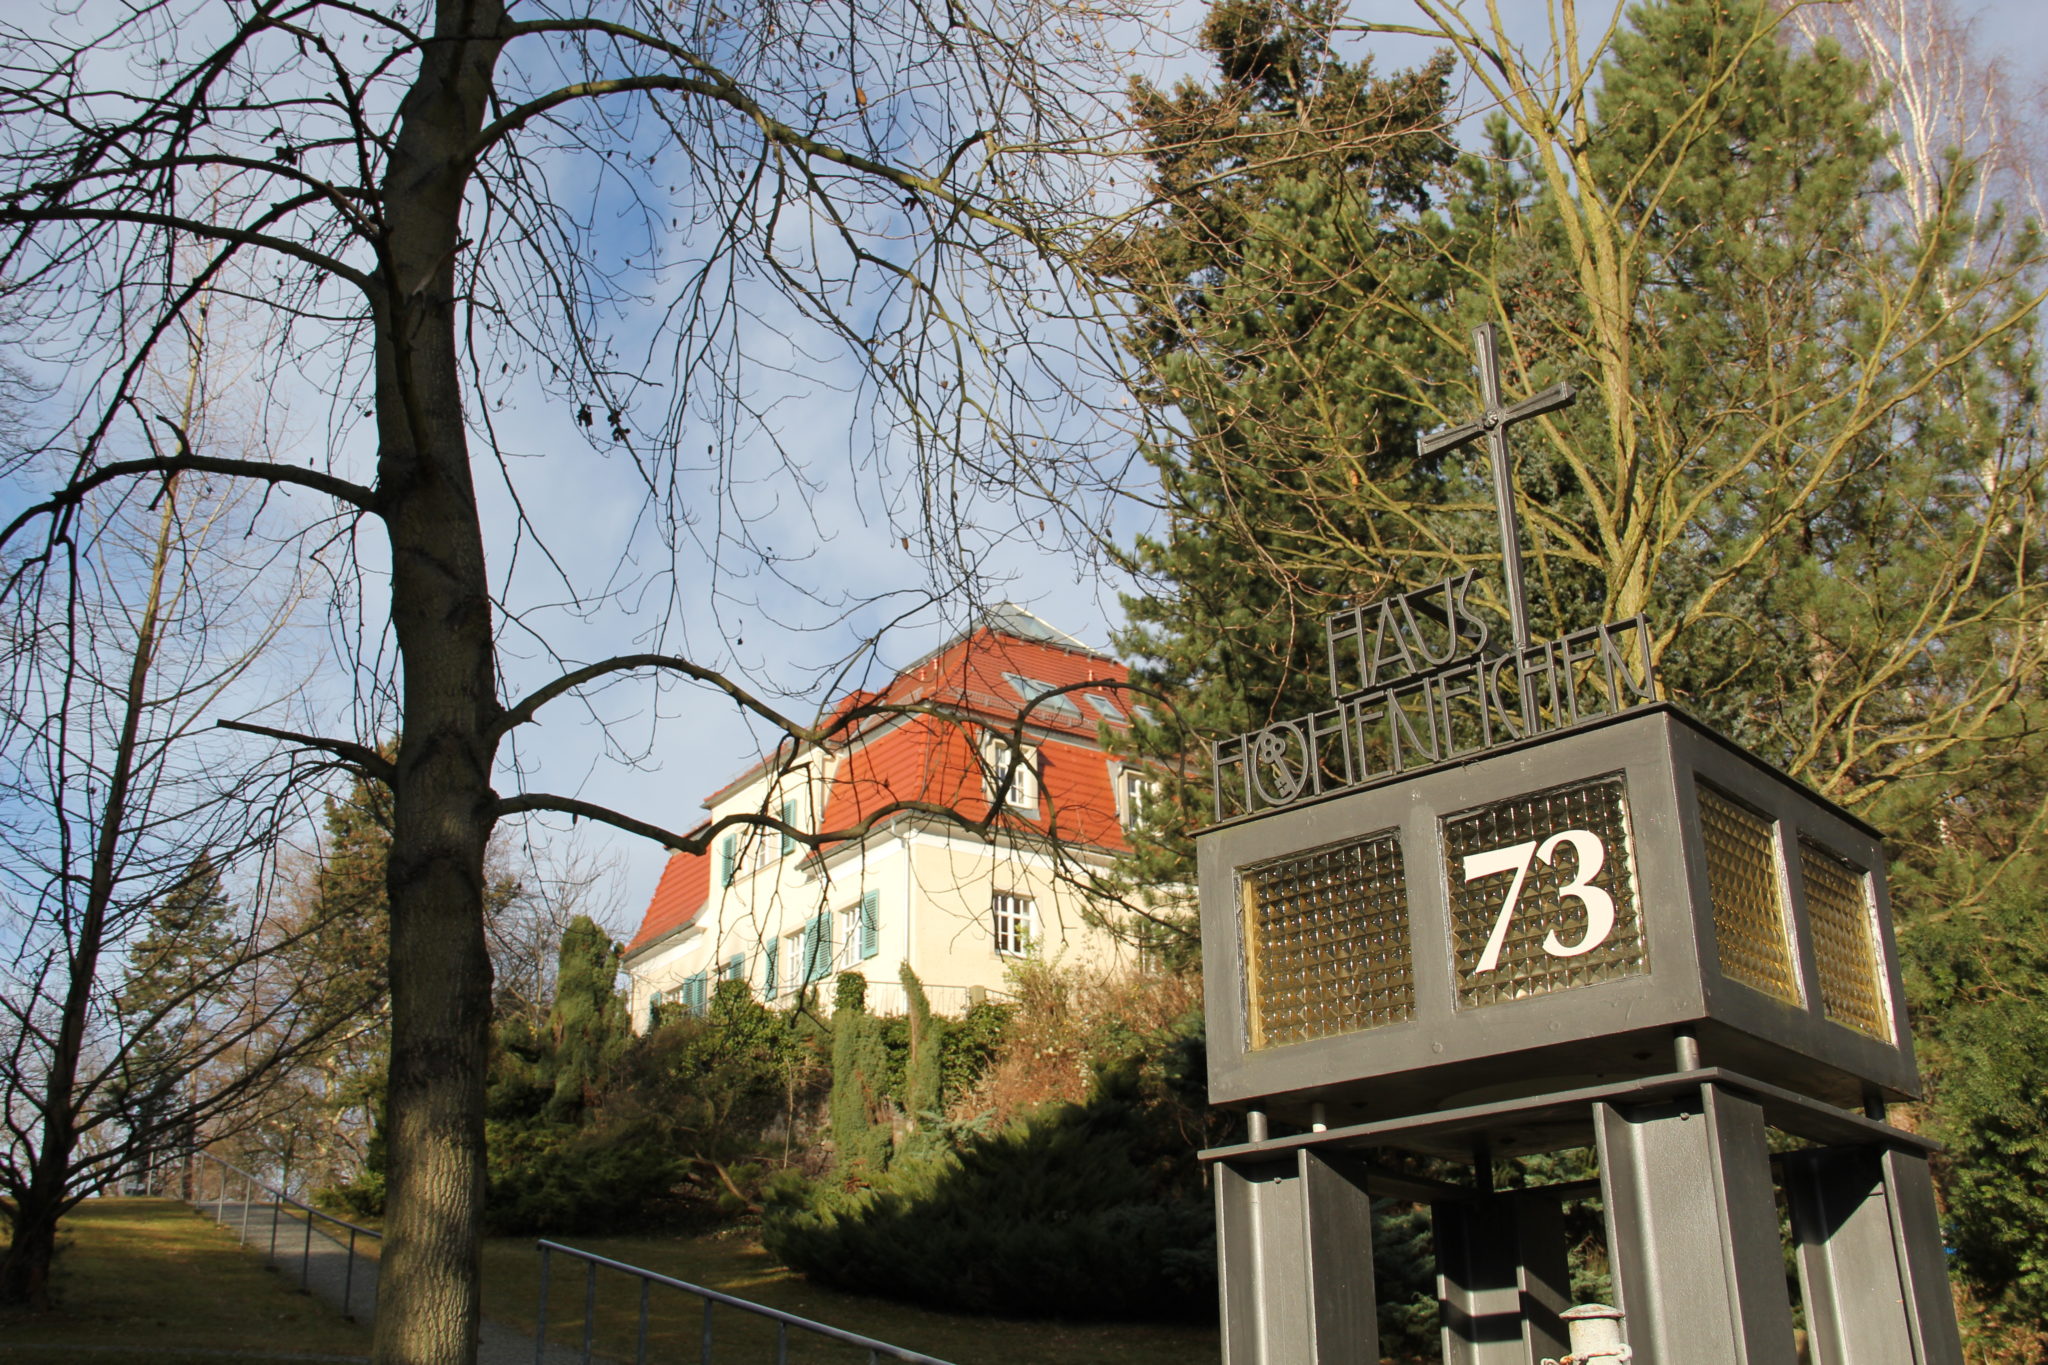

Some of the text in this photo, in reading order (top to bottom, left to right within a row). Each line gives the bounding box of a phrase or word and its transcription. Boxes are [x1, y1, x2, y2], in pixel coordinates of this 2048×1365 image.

[1326, 568, 1489, 698] HAUS
[1212, 613, 1656, 823] HOHENEICHEN
[1463, 829, 1615, 973] 73
